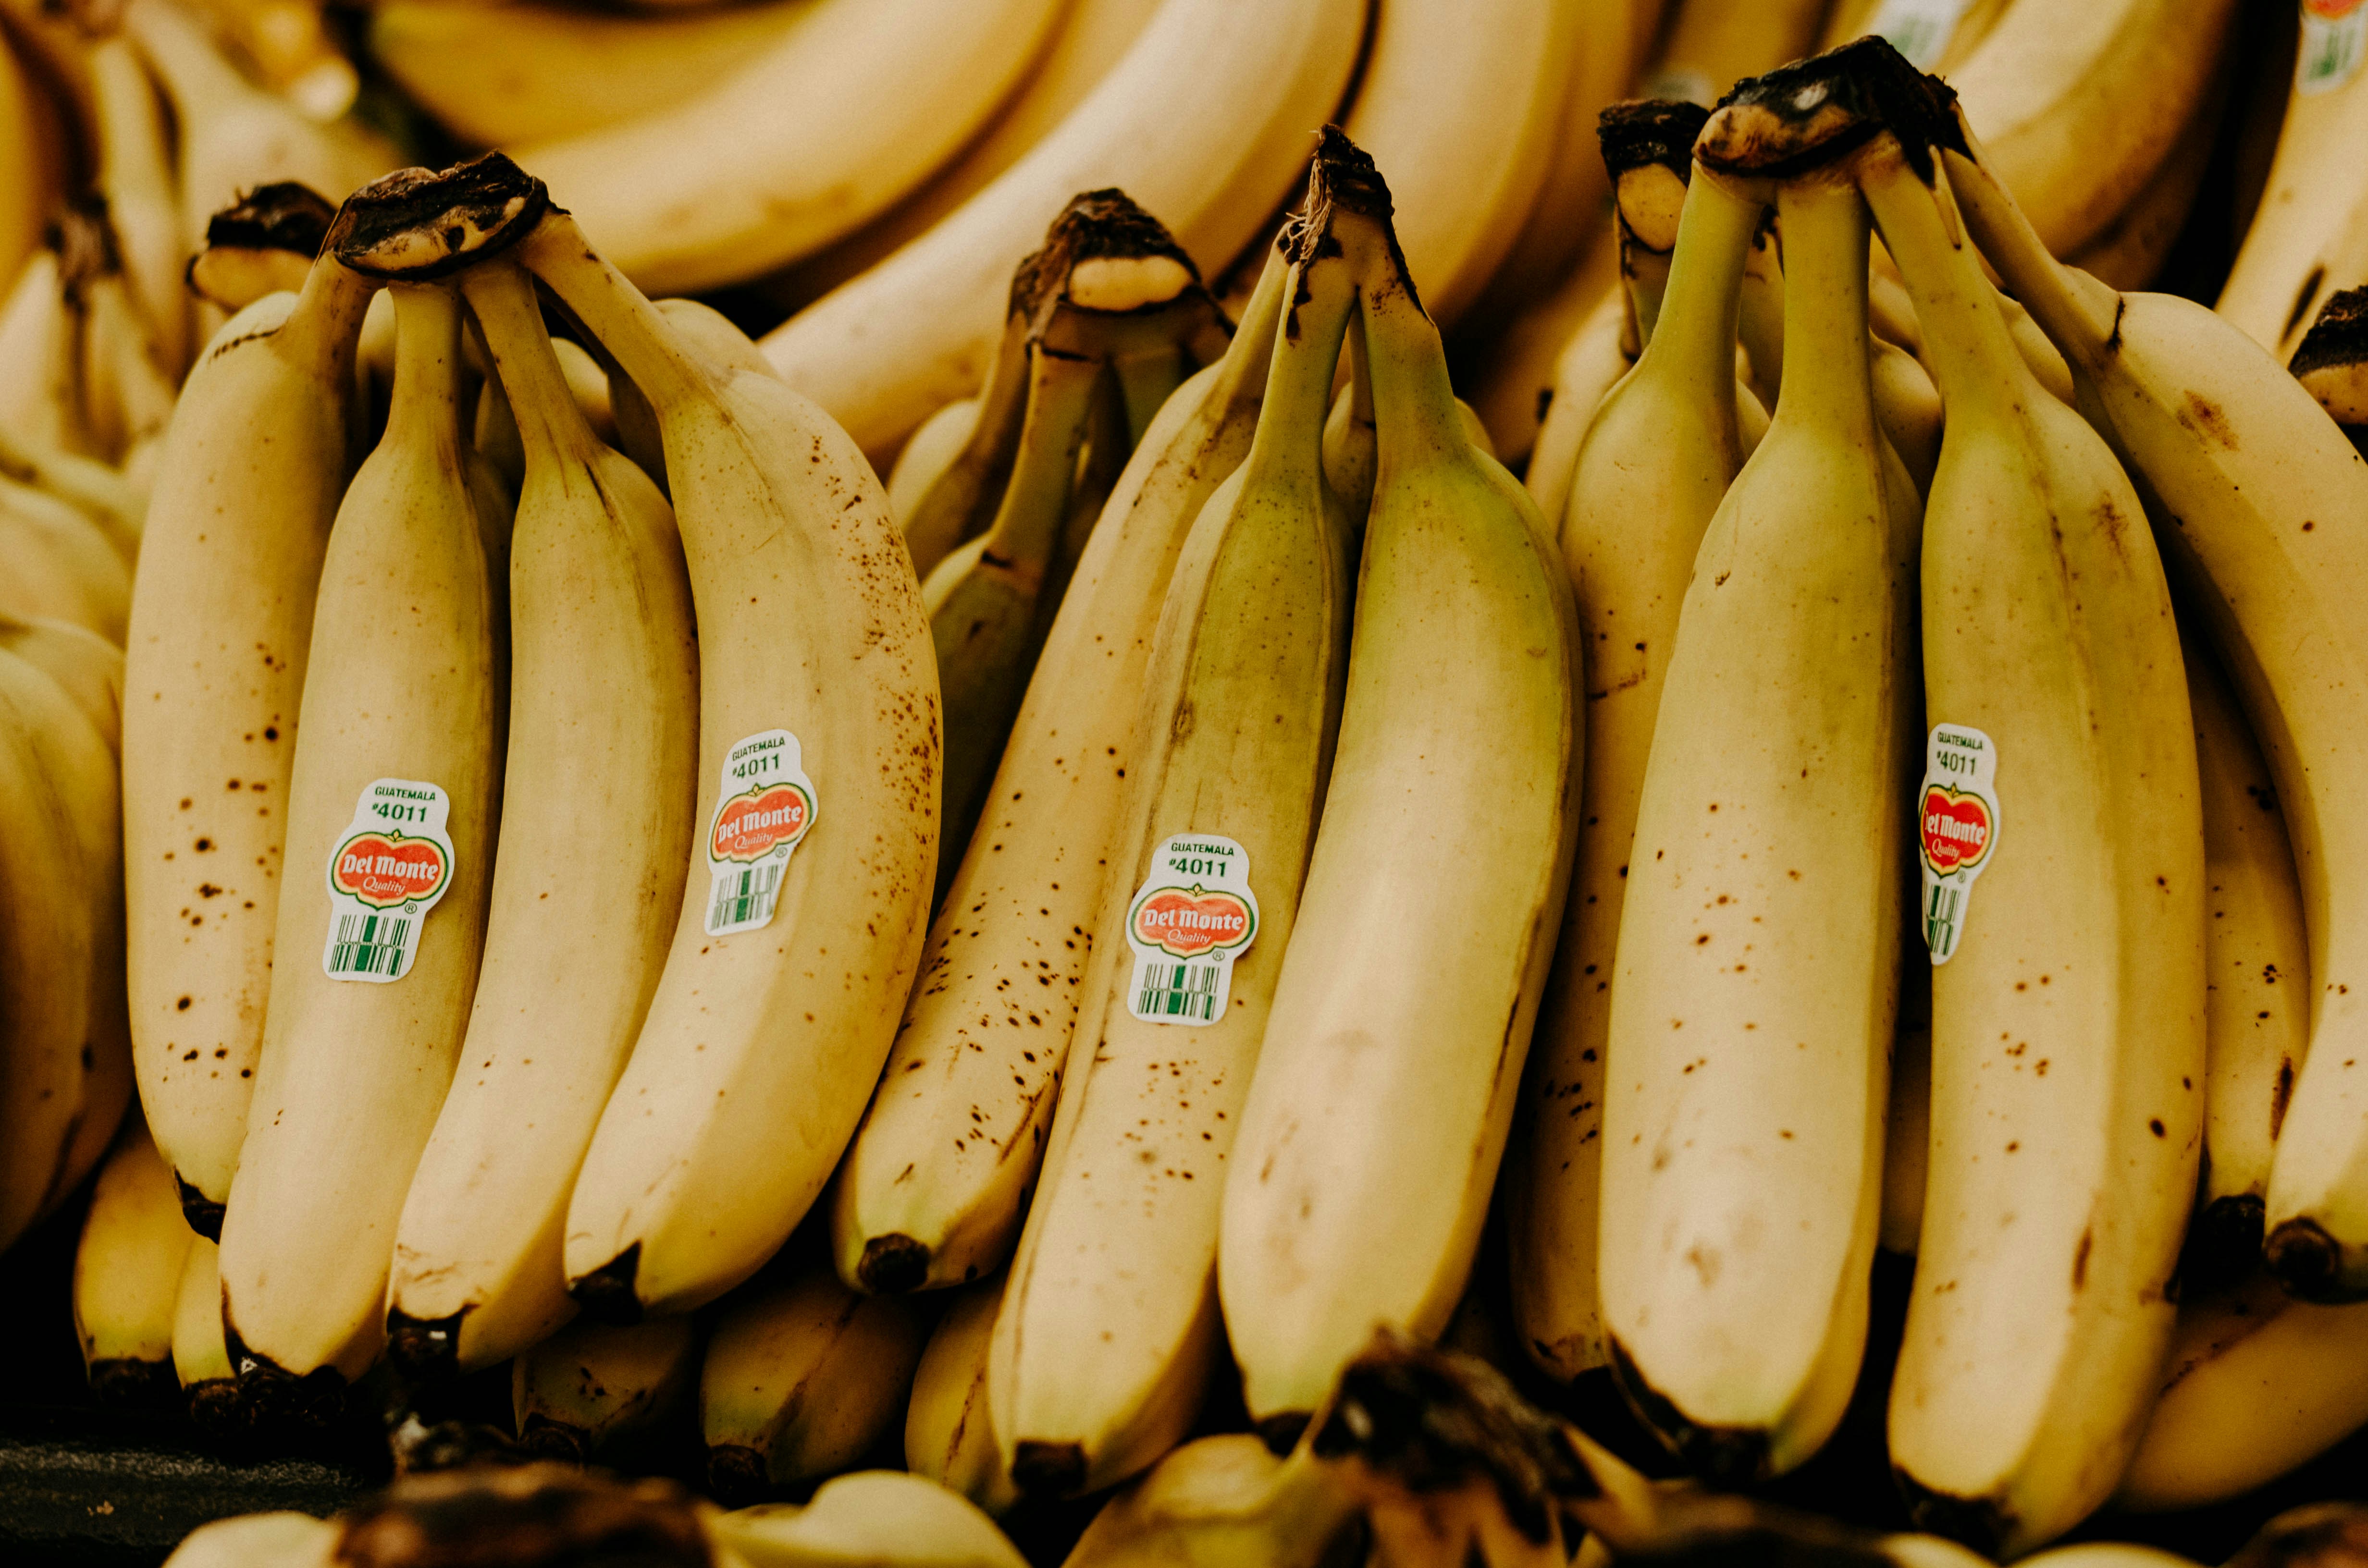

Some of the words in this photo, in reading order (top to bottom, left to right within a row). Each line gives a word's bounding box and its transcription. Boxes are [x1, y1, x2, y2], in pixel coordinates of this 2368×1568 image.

[732, 736, 786, 761] GUATEMALA
[1937, 731, 1984, 751] GUATEMALA
[375, 786, 436, 801] GUATEMALA
[718, 821, 740, 844] Del
[743, 805, 802, 833] Monte
[1941, 815, 1985, 845] Monte
[734, 833, 773, 849] Quality
[1171, 843, 1234, 857] GUATEMALA
[1932, 838, 1960, 860] Quality
[342, 854, 373, 874] Del
[375, 856, 438, 881] Monte
[363, 876, 406, 895] Quality
[1144, 909, 1174, 927] Del
[1179, 910, 1243, 931] Monte
[1167, 929, 1211, 944] Quality
